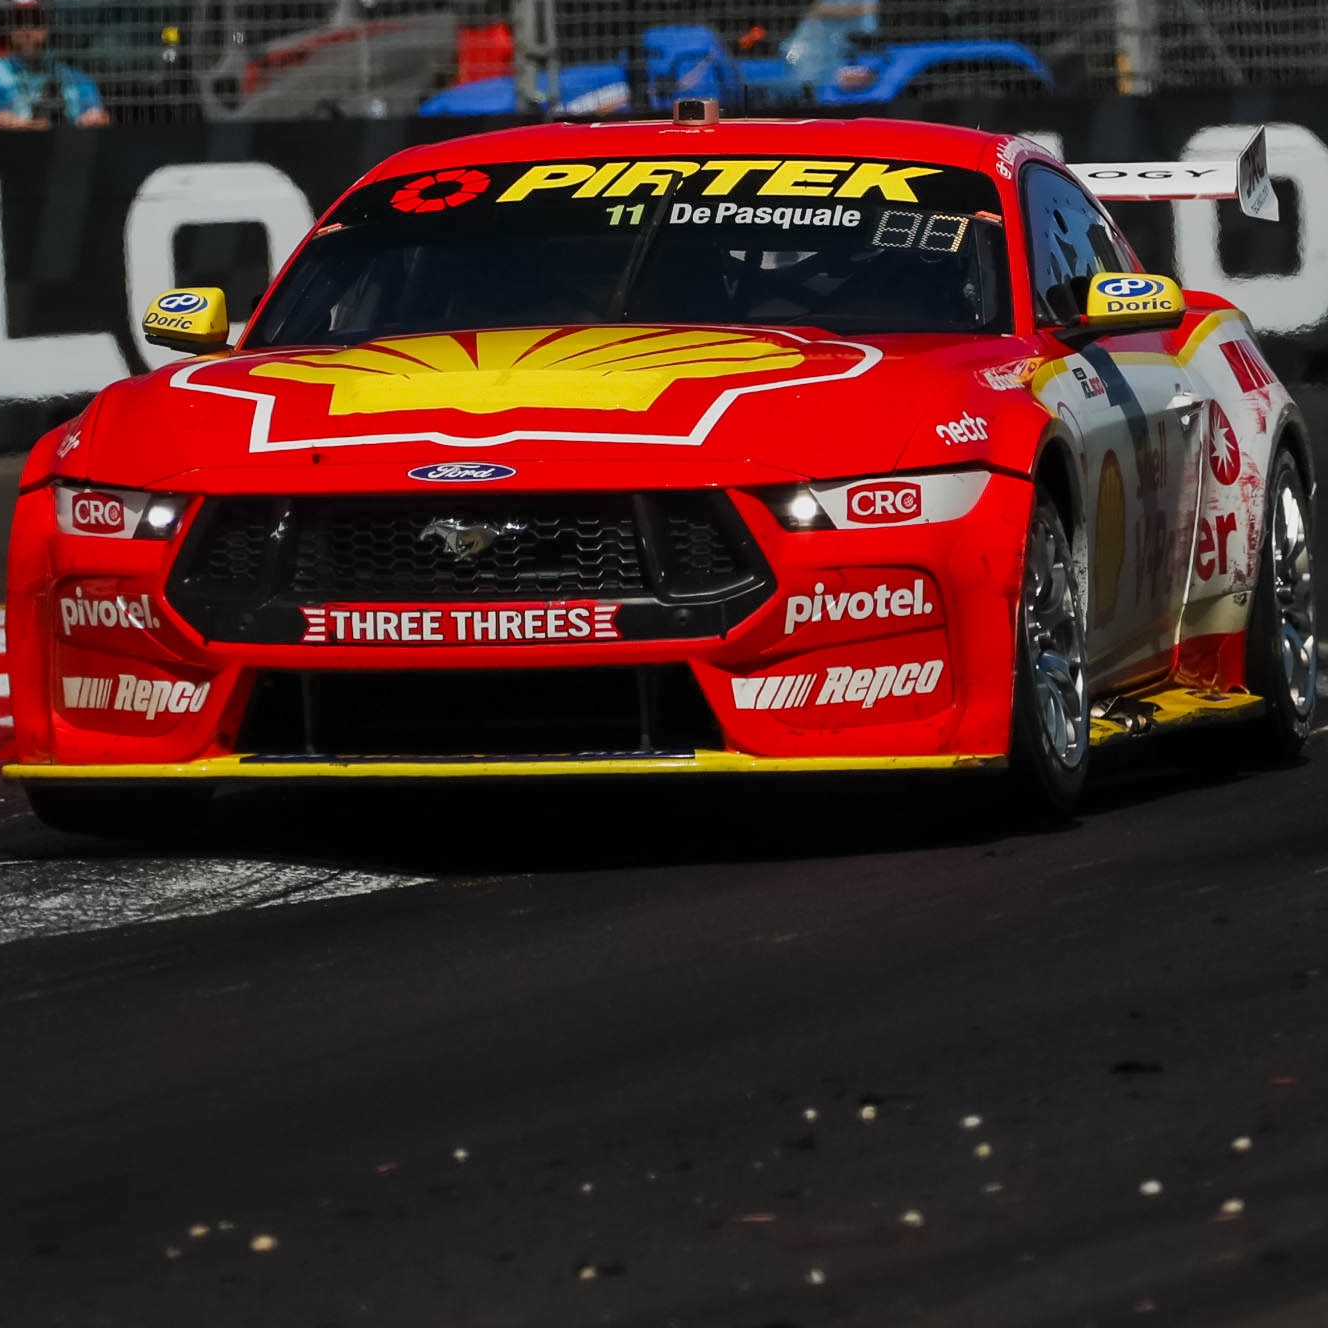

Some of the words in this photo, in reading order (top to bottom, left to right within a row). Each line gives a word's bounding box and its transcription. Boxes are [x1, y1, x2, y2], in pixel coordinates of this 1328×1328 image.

[495, 160, 944, 203] PIRTEK
[1087, 168, 1218, 179] OGY
[605, 204, 645, 226] 11
[670, 202, 708, 225] De
[711, 203, 861, 229] Pasquale
[1107, 298, 1173, 313] Doric
[144, 312, 193, 330] Doric
[427, 463, 494, 480] Ford
[74, 499, 121, 526] CRC
[851, 488, 918, 516] CRC
[784, 579, 933, 635] pivotel.
[329, 610, 444, 641] THREE
[450, 608, 591, 641] THREES
[114, 673, 211, 720] Repco
[815, 659, 944, 709] Repco
